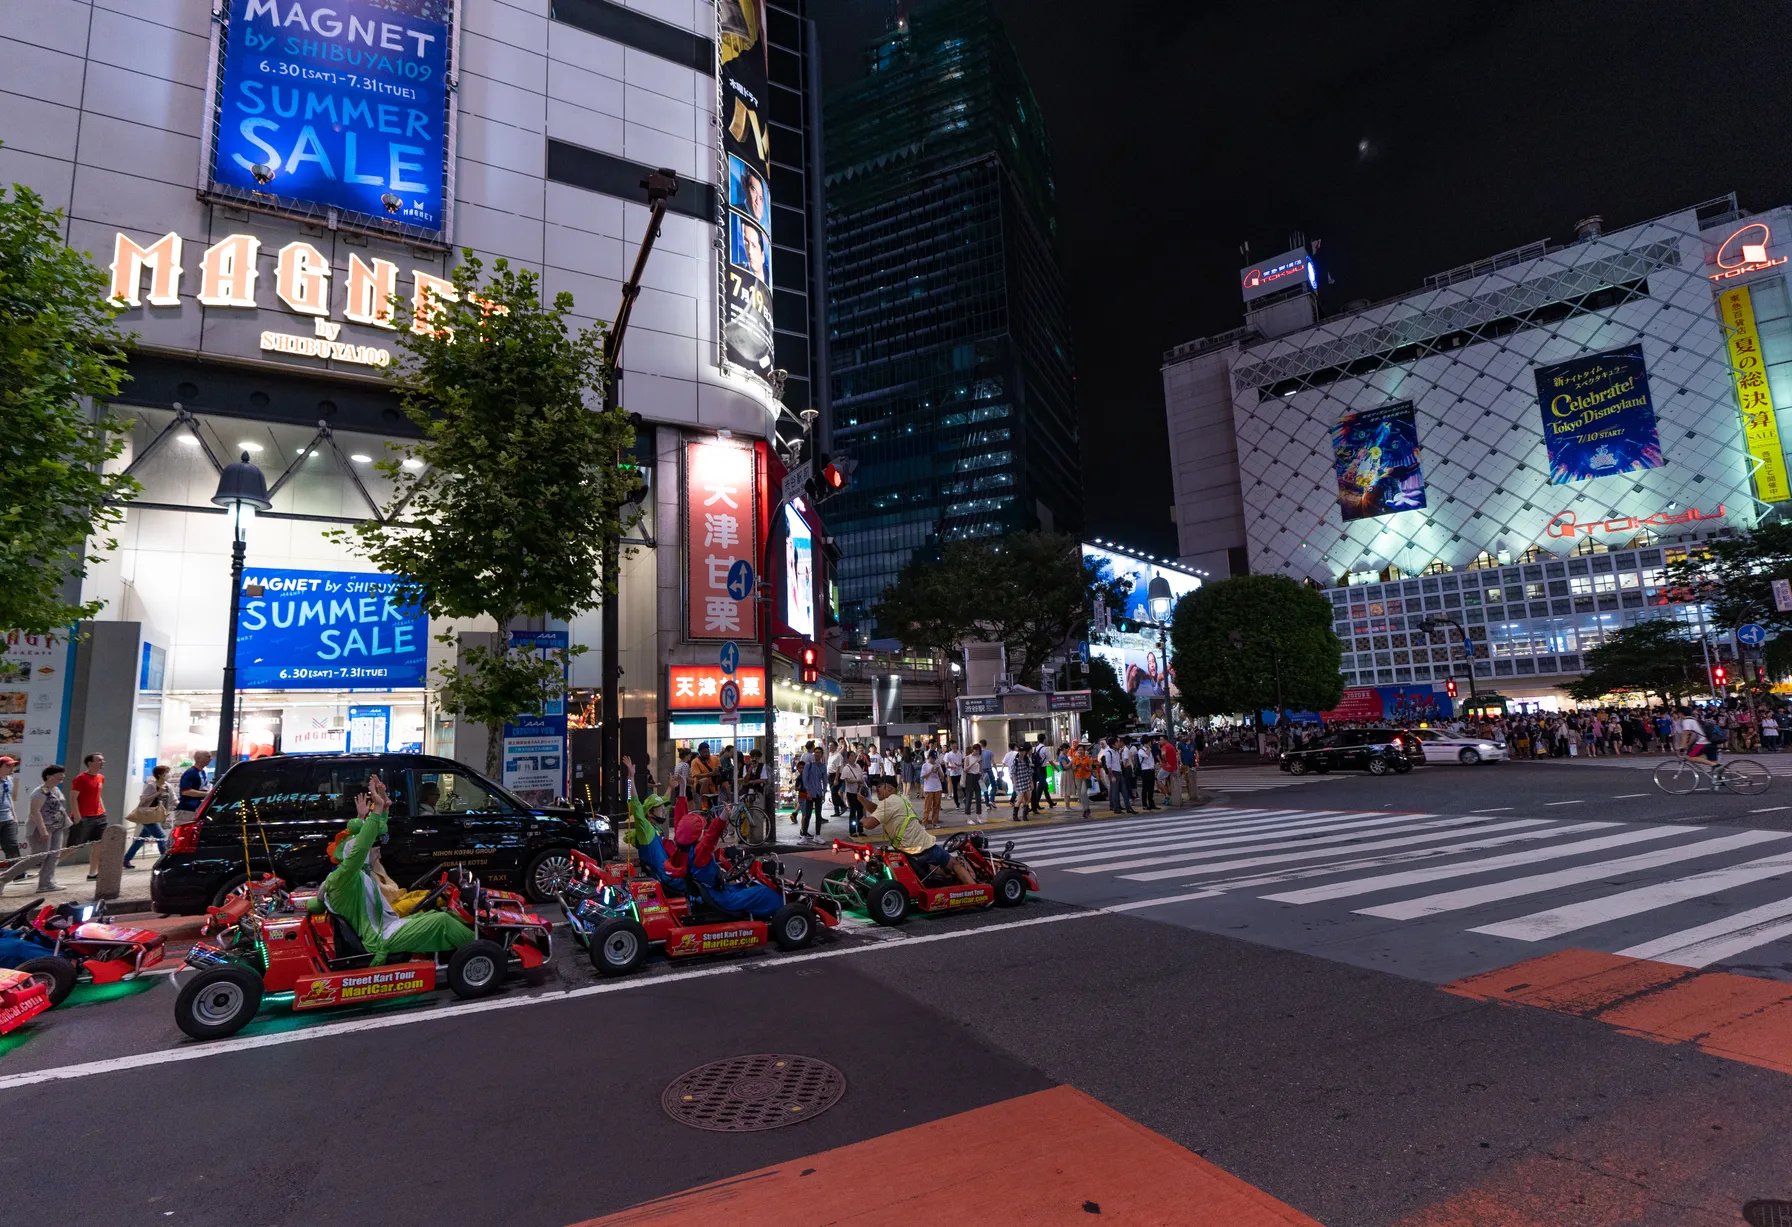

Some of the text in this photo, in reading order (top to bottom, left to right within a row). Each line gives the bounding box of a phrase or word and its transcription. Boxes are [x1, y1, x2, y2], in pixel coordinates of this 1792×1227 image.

[243, 0, 436, 58] MAGNET
[244, 27, 432, 81] by SHIBUYA109
[236, 80, 432, 140] SUMMER
[231, 117, 430, 194] SALE
[1260, 264, 1304, 283] TOKYU
[1708, 255, 1789, 281] TOKYU
[314, 317, 341, 341] by
[260, 331, 391, 367] SHIBUYA109
[1553, 365, 1603, 387] 新ナイトタイム
[1575, 365, 1628, 389] スペクタキュラー
[1734, 336, 1773, 430] 夏の総決算
[1551, 376, 1635, 417] Celebrate!
[1547, 395, 1648, 435] Tokyo Disneyland
[1576, 428, 1625, 444] 7/10 START!
[1749, 430, 1777, 441] SALE
[1573, 504, 1726, 535] TOKYU
[242, 576, 321, 592] MAGNET
[325, 580, 342, 593] by
[242, 596, 404, 631] SUMMER
[316, 625, 417, 661] SALE
[675, 676, 761, 697] 天津栗
[295, 731, 345, 744] MAGNET
[432, 849, 453, 857] NIHON
[454, 848, 475, 856] KOTSU
[950, 895, 989, 905] MariCar.com
[702, 936, 759, 949] MariCar.com
[703, 929, 753, 941] Street Kart Tour
[341, 979, 424, 998] MariCar.com
[342, 970, 416, 987] Street Kart Tour
